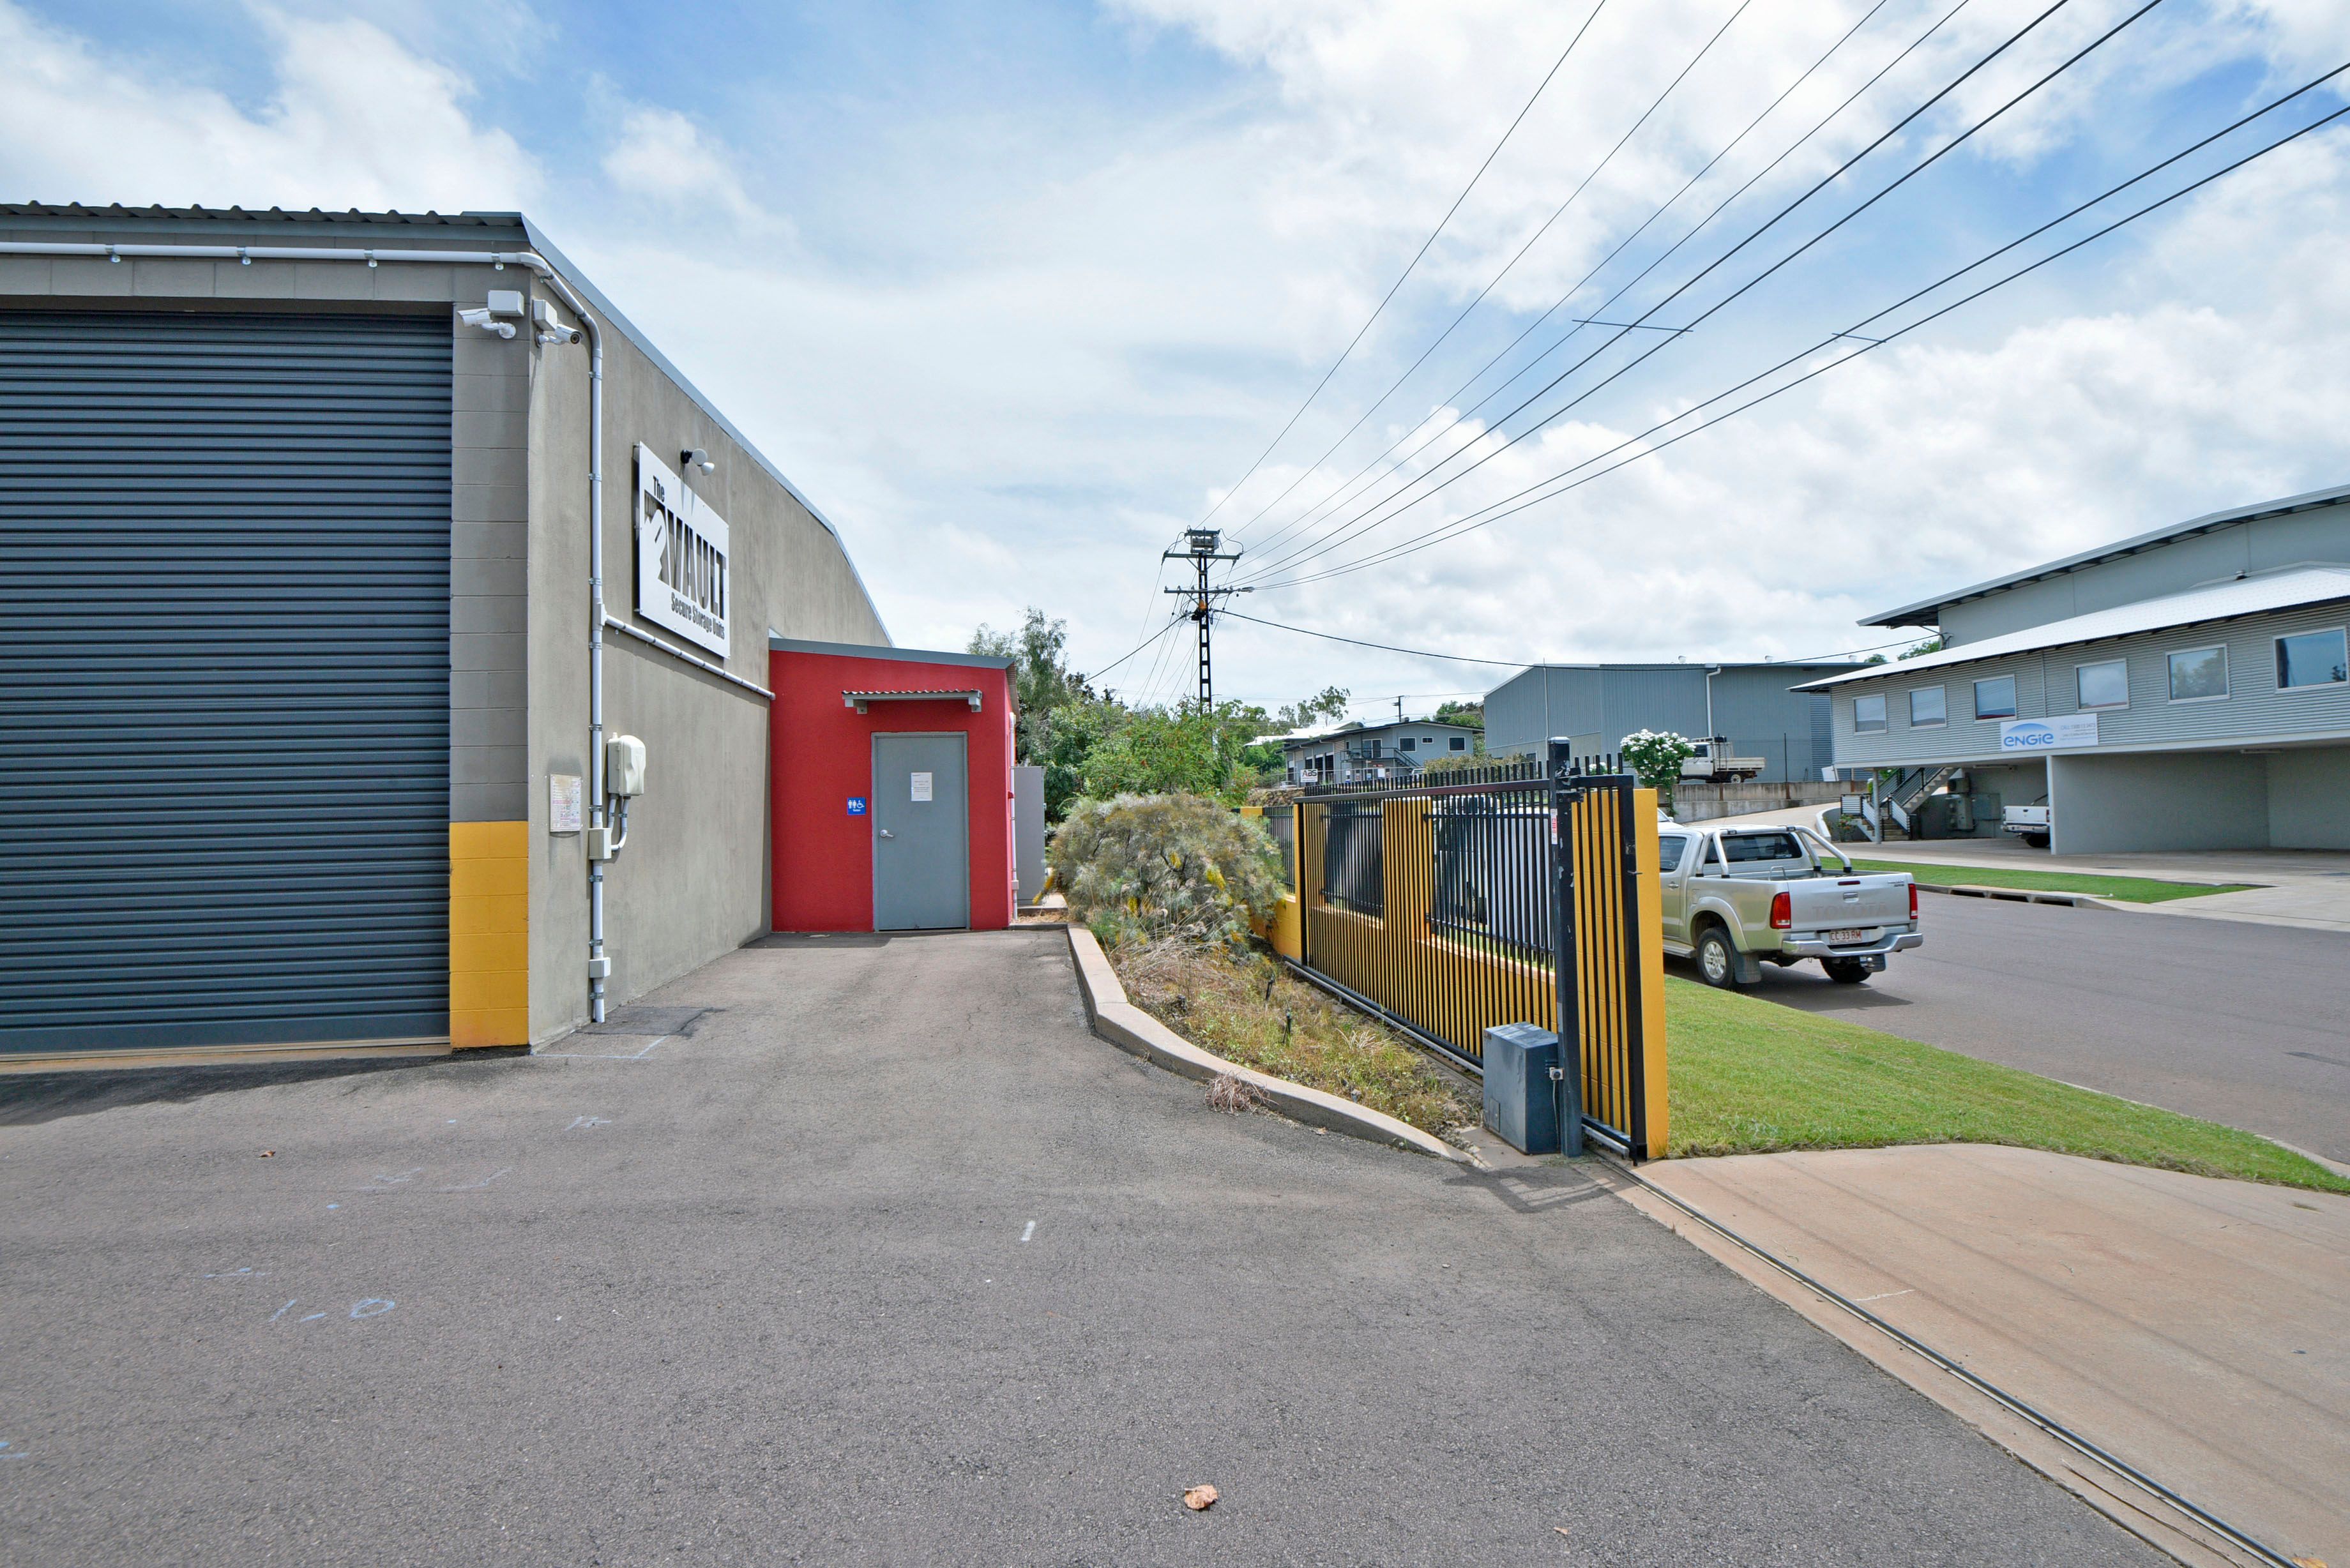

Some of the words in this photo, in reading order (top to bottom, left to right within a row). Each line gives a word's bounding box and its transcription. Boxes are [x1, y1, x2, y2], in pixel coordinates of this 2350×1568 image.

[653, 475, 665, 503] The
[667, 508, 726, 621] VAULT
[671, 591, 692, 621] Secure
[693, 605, 712, 633] Storage
[713, 617, 725, 640] Units
[1812, 901, 1890, 920] TOYOTA
